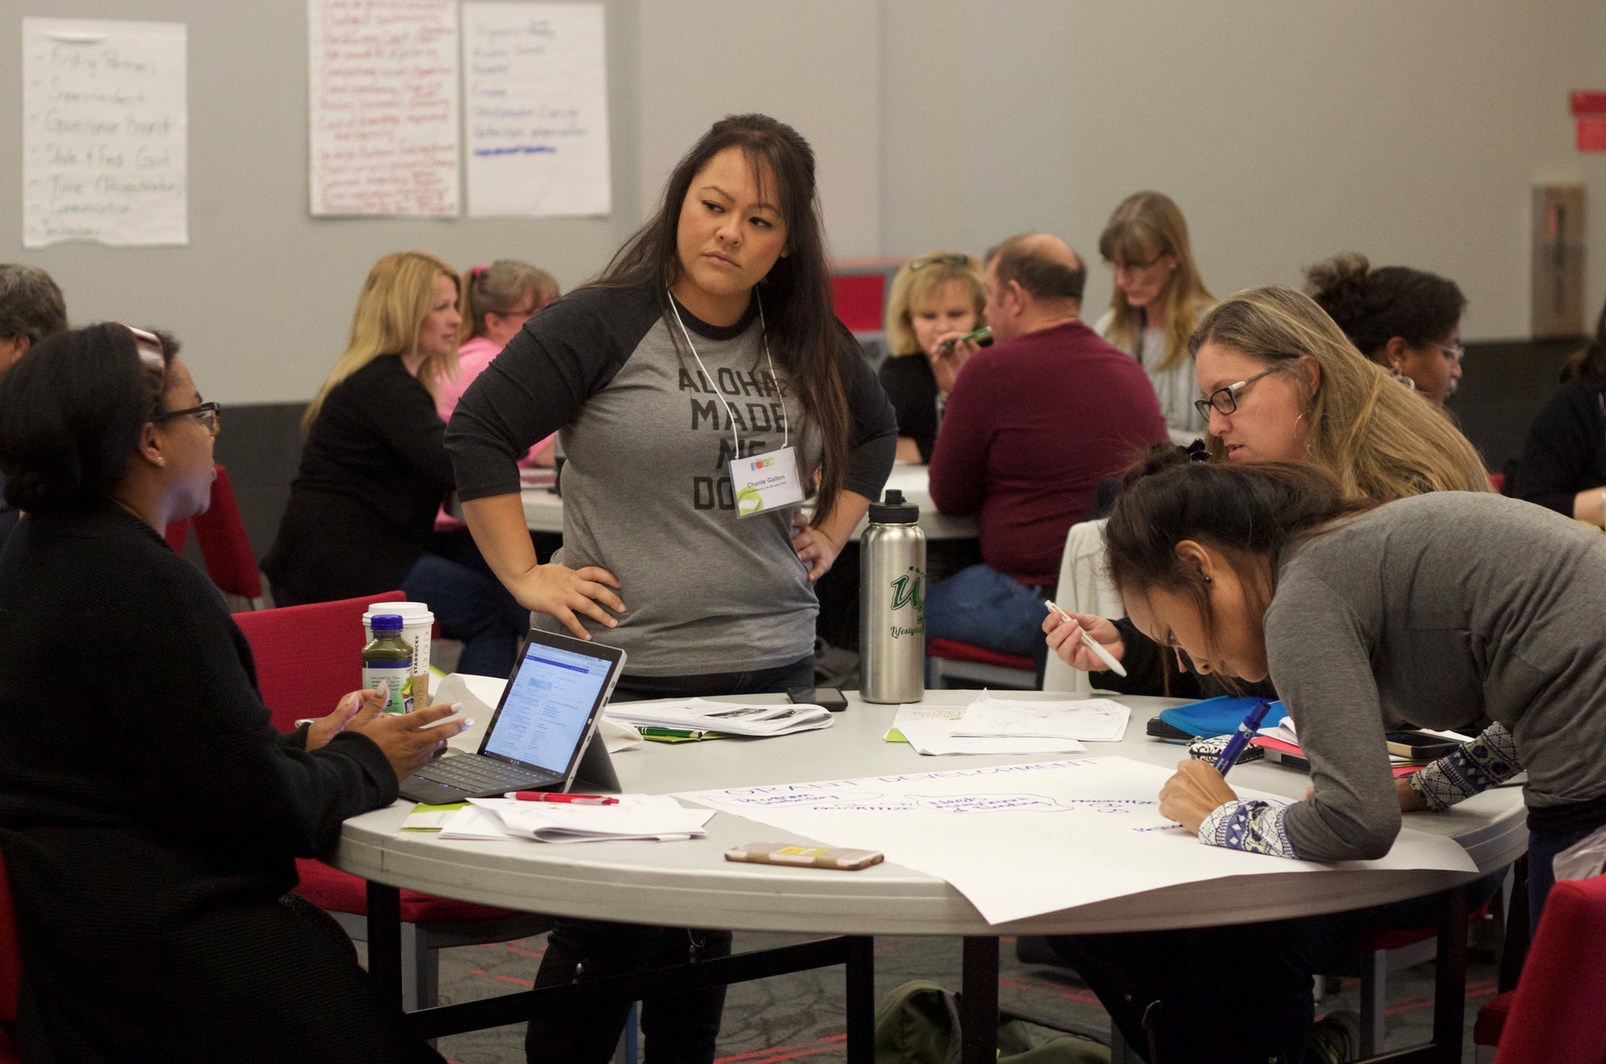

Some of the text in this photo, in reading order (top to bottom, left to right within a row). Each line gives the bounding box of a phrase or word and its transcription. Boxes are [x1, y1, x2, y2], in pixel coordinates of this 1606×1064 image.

[679, 367, 787, 397] ALOHA
[691, 398, 792, 433] MADE
[878, 759, 1098, 784] DEVELOPMENT
